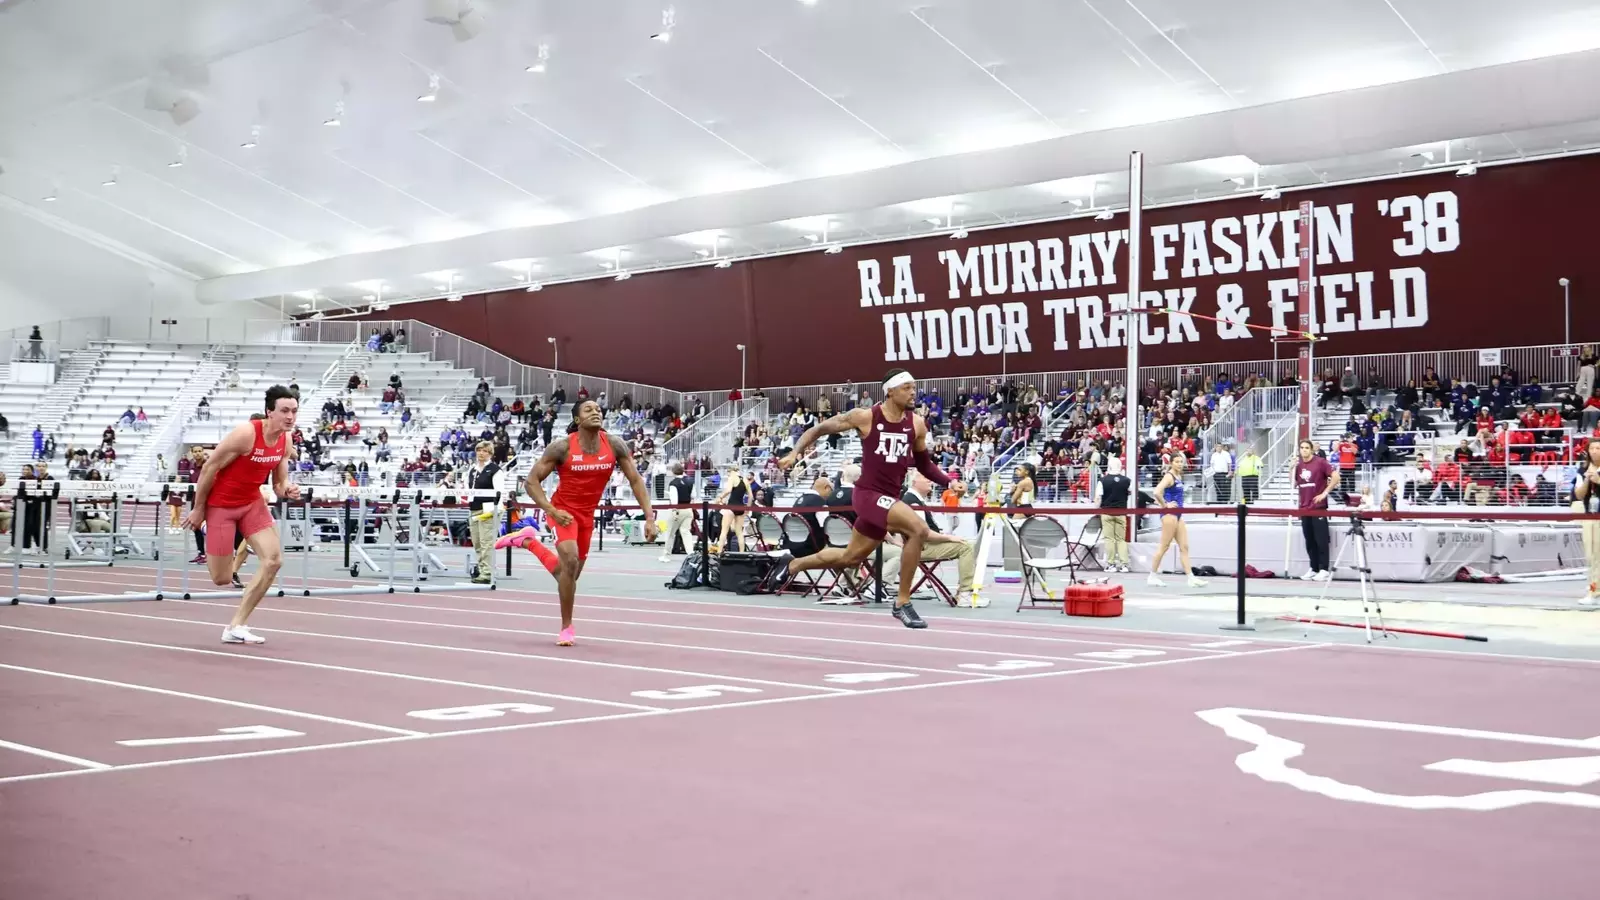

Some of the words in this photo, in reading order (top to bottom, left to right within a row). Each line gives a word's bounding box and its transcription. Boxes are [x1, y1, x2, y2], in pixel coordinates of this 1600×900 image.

[857, 254, 926, 308] R.A.
[1377, 190, 1461, 257] '38
[882, 301, 1032, 362] INDOOR
[1043, 286, 1200, 351] TRACK
[1215, 282, 1253, 341] &
[250, 455, 283, 463] HOUSTON
[571, 463, 612, 471] HOUSTON
[91, 483, 116, 491] TEXAS
[1342, 532, 1382, 542] TXAS
[1386, 532, 1413, 542] A&M
[630, 684, 763, 700] 5
[407, 702, 555, 721] 6
[116, 725, 306, 746] 7
